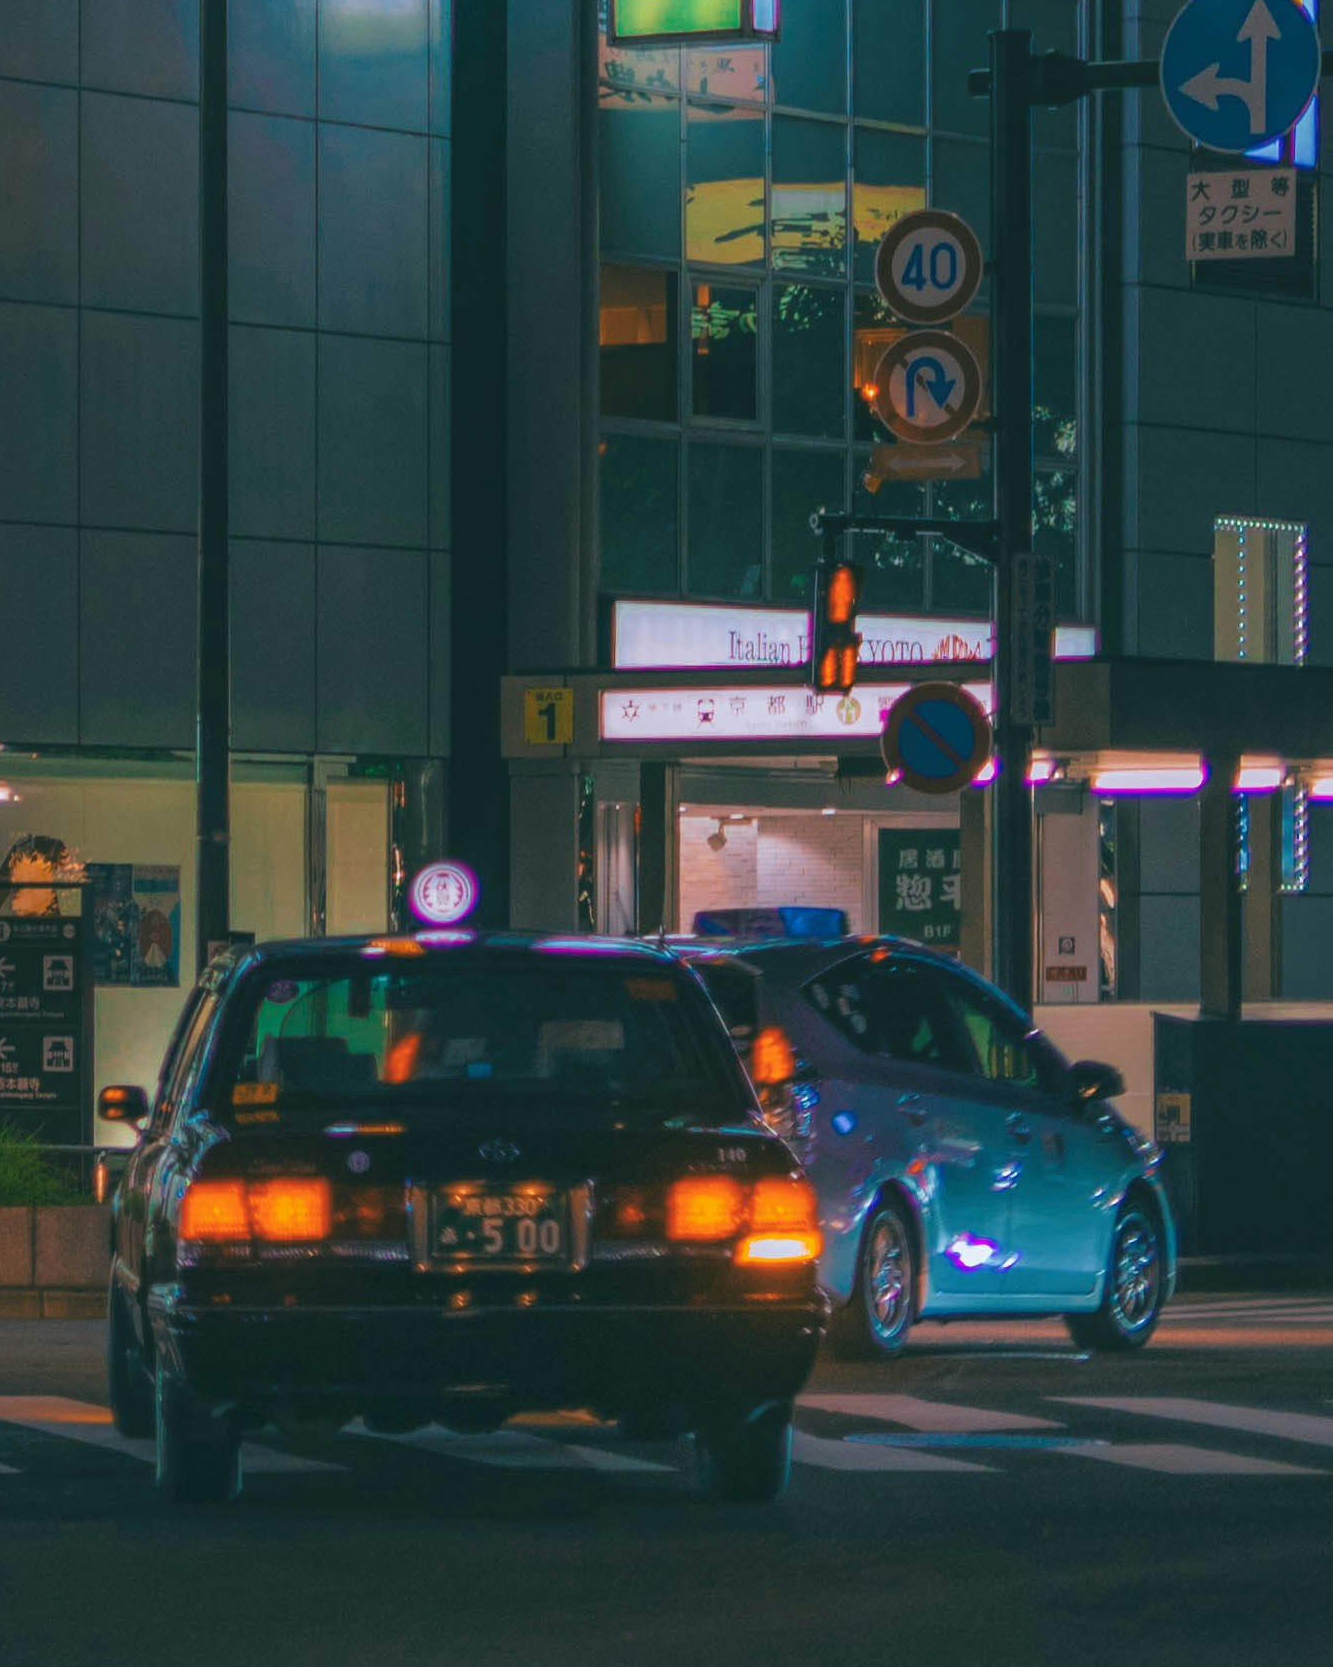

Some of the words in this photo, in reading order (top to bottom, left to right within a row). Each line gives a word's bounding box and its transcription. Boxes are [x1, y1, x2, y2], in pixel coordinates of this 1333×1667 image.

[1191, 176, 1290, 202] 大型等
[1198, 204, 1282, 226] タクシー
[901, 240, 958, 294] 40
[727, 630, 791, 665] Italian
[728, 694, 825, 716] 京都駅
[538, 703, 557, 741] 1
[924, 924, 952, 939] B1F
